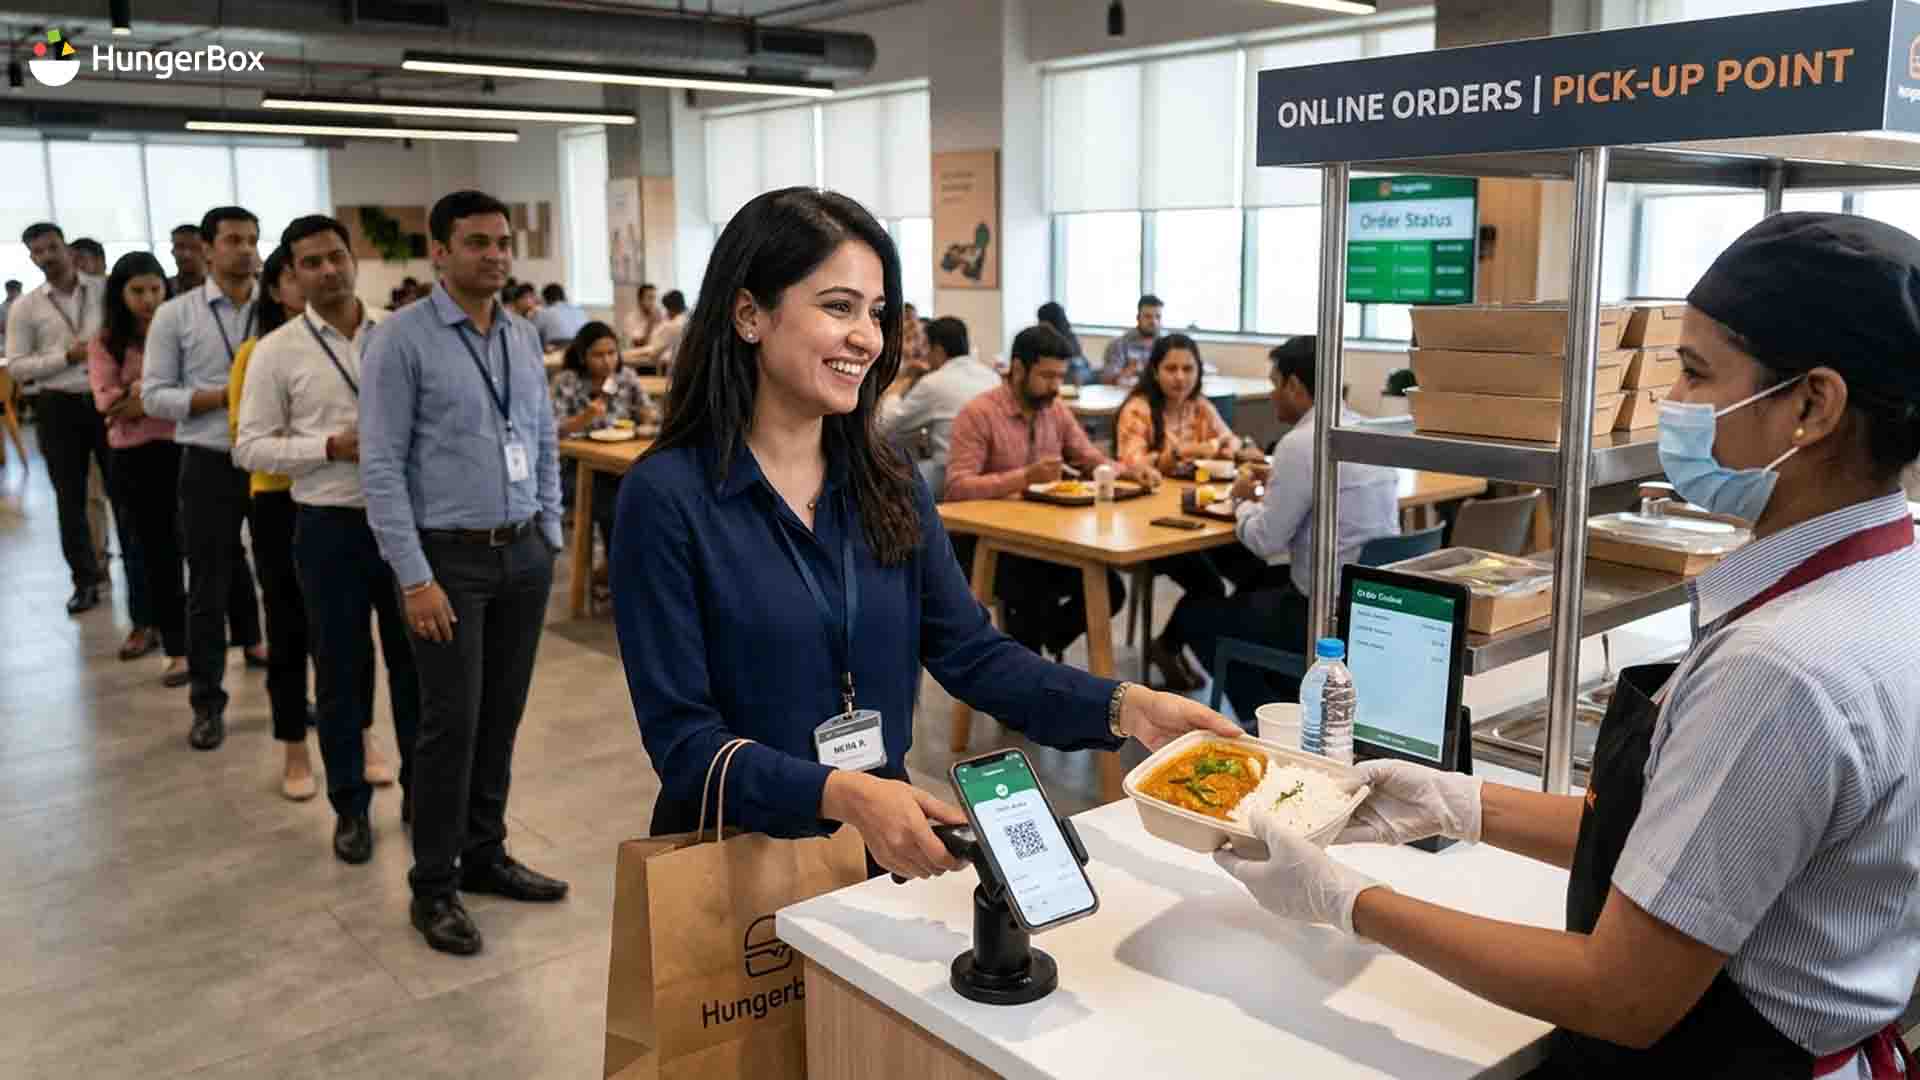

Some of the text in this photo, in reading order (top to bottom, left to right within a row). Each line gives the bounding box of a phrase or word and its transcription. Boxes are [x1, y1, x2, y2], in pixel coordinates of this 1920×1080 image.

[1278, 93, 1384, 128] ONLINE
[1392, 80, 1522, 119] ORDERS
[1552, 63, 1704, 106] PICK-UP
[1717, 48, 1854, 94] POINT
[1360, 212, 1452, 229] Order Status
